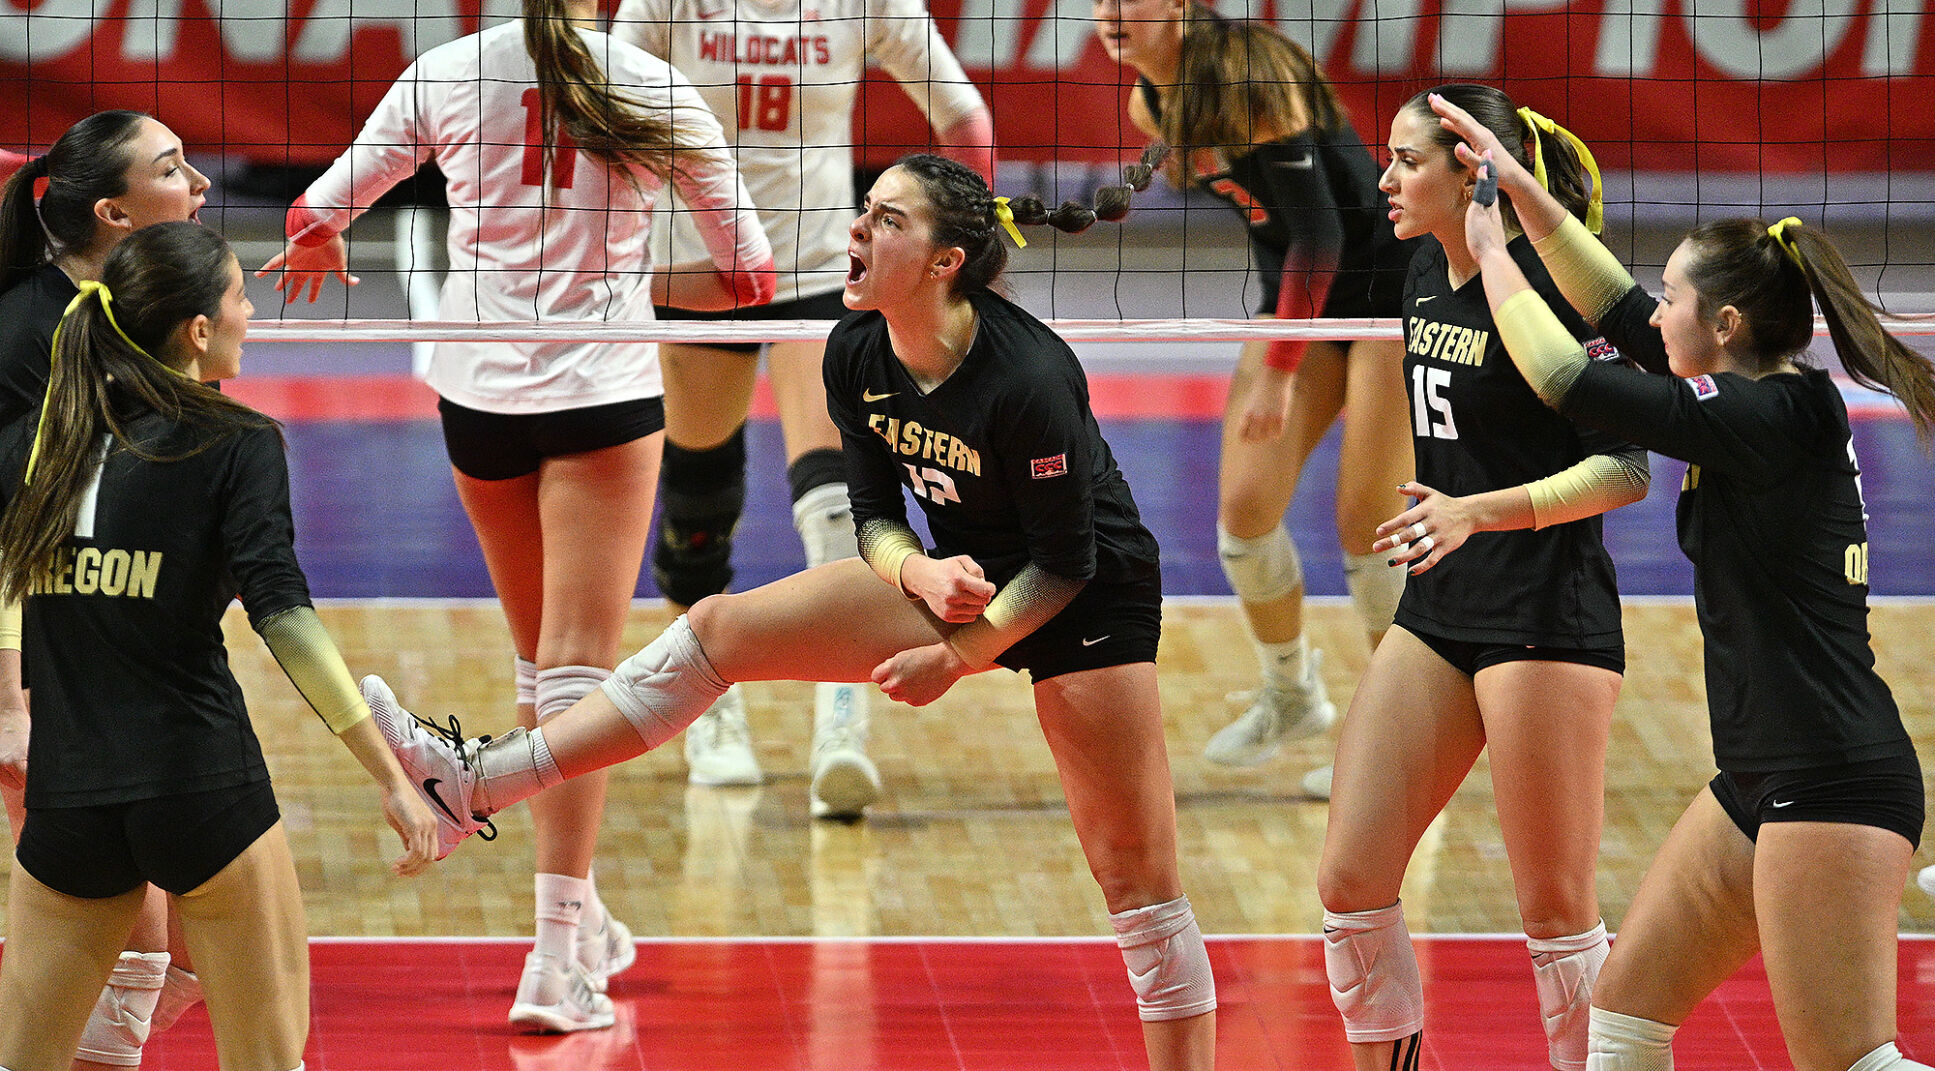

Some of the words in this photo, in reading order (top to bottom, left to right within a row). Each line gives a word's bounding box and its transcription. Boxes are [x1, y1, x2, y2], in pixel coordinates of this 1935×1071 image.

[699, 29, 830, 65] WILDCATS
[737, 73, 792, 132] 18
[1408, 316, 1489, 367] EASTERN
[1412, 364, 1458, 440] 15
[868, 413, 981, 477] EASTERN
